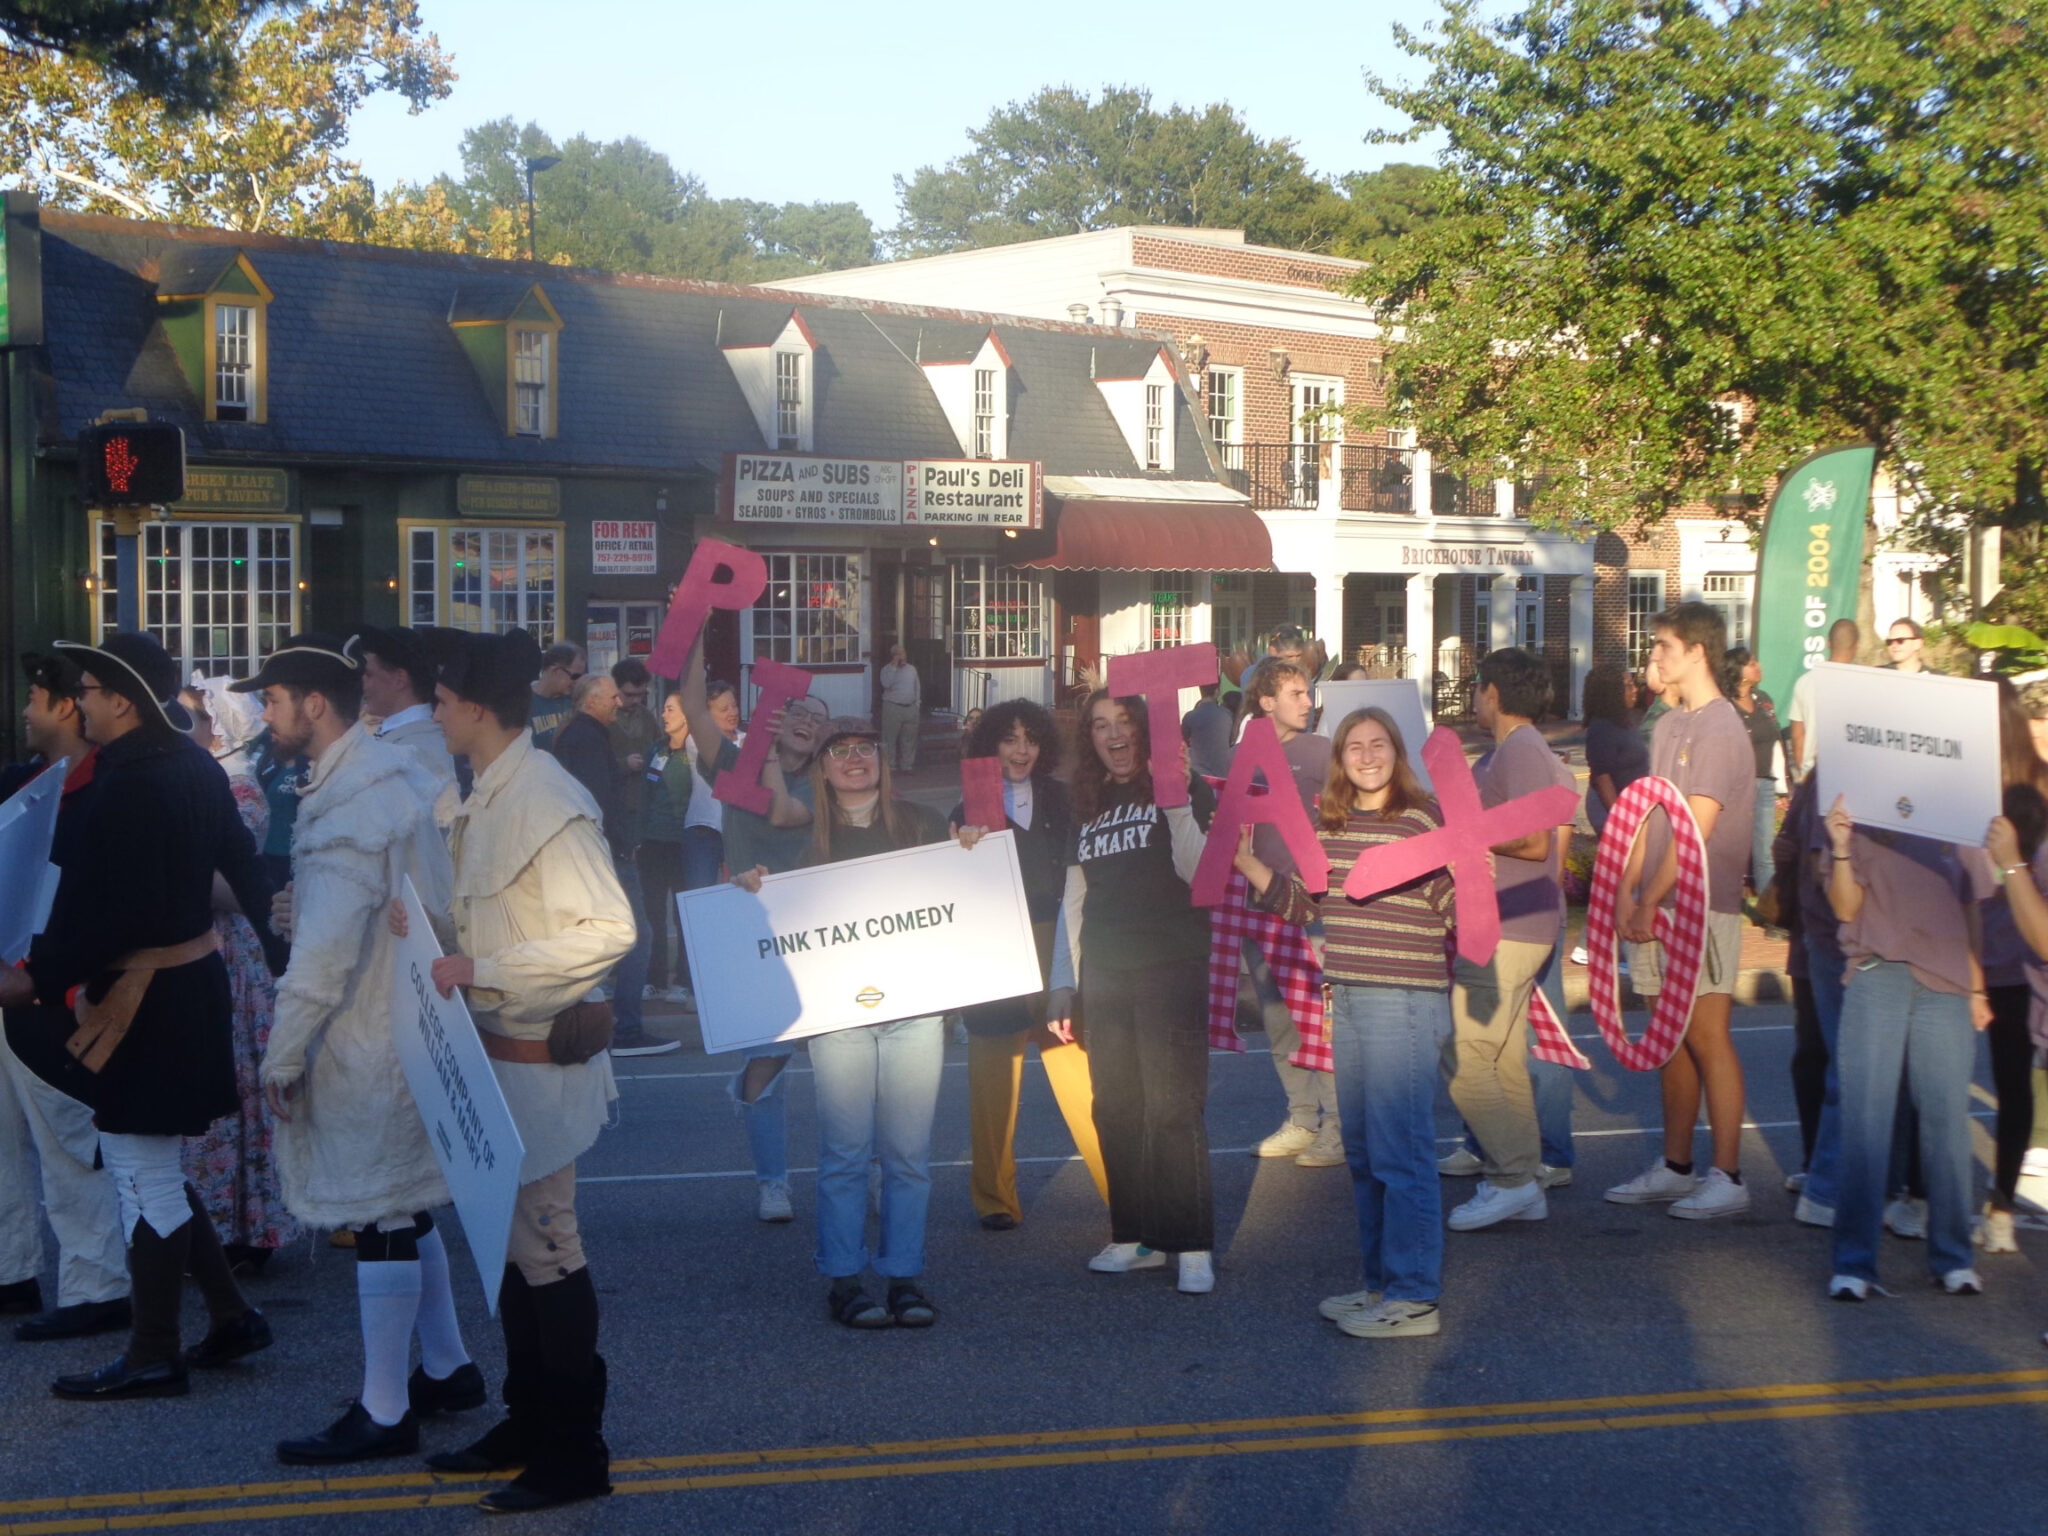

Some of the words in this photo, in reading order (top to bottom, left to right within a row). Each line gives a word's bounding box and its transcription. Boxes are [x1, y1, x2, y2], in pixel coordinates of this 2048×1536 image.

[232, 475, 274, 488] LEAFE
[740, 460, 794, 482] PIZZA
[798, 465, 819, 480] AND
[822, 463, 870, 485] SUBS
[925, 467, 980, 487] Paul's
[989, 469, 1024, 488] Deli
[185, 489, 208, 502] PUB
[213, 490, 221, 502] &
[225, 490, 270, 502] TAVERN
[757, 488, 794, 502] SOUPS
[801, 491, 823, 503] AND
[828, 491, 879, 505] SPECIALS
[906, 465, 917, 520] PIZZA
[924, 490, 1023, 508] Restaurant
[738, 505, 783, 518] SEAFOOD
[795, 506, 826, 519] GYROS
[838, 507, 896, 521] STROMBOLIS
[924, 513, 973, 522] PARKING
[978, 513, 989, 522] IN
[994, 514, 1022, 523] REAR
[594, 522, 619, 539] FOR
[622, 522, 654, 539] RENT
[595, 541, 621, 551] OFFICE
[629, 541, 654, 551] RETAIL
[1402, 546, 1481, 566] BRICKHOUSE
[1486, 547, 1533, 566] TAVERN
[1807, 523, 1832, 588] 2004
[1805, 595, 1827, 628] OF
[646, 536, 767, 680] P
[712, 657, 813, 816] I
[1846, 723, 1884, 747] SIGMA
[1885, 730, 1907, 751] PHI
[1909, 733, 1962, 760] EPSILON
[1107, 642, 1219, 808] T
[1191, 717, 1332, 907] A
[1343, 725, 1580, 967] X
[1079, 802, 1158, 839] WILLIAM
[1078, 838, 1093, 863] &
[1094, 824, 1152, 858] MARY
[757, 931, 812, 960] PINK
[815, 922, 860, 948] TAX
[865, 903, 956, 938] COMEDY
[411, 961, 445, 1050] COLLEGE
[445, 1041, 484, 1144] COMPANY
[483, 1139, 495, 1171] OF
[419, 1007, 451, 1097] WILLIAM
[457, 1105, 480, 1170] MARY
